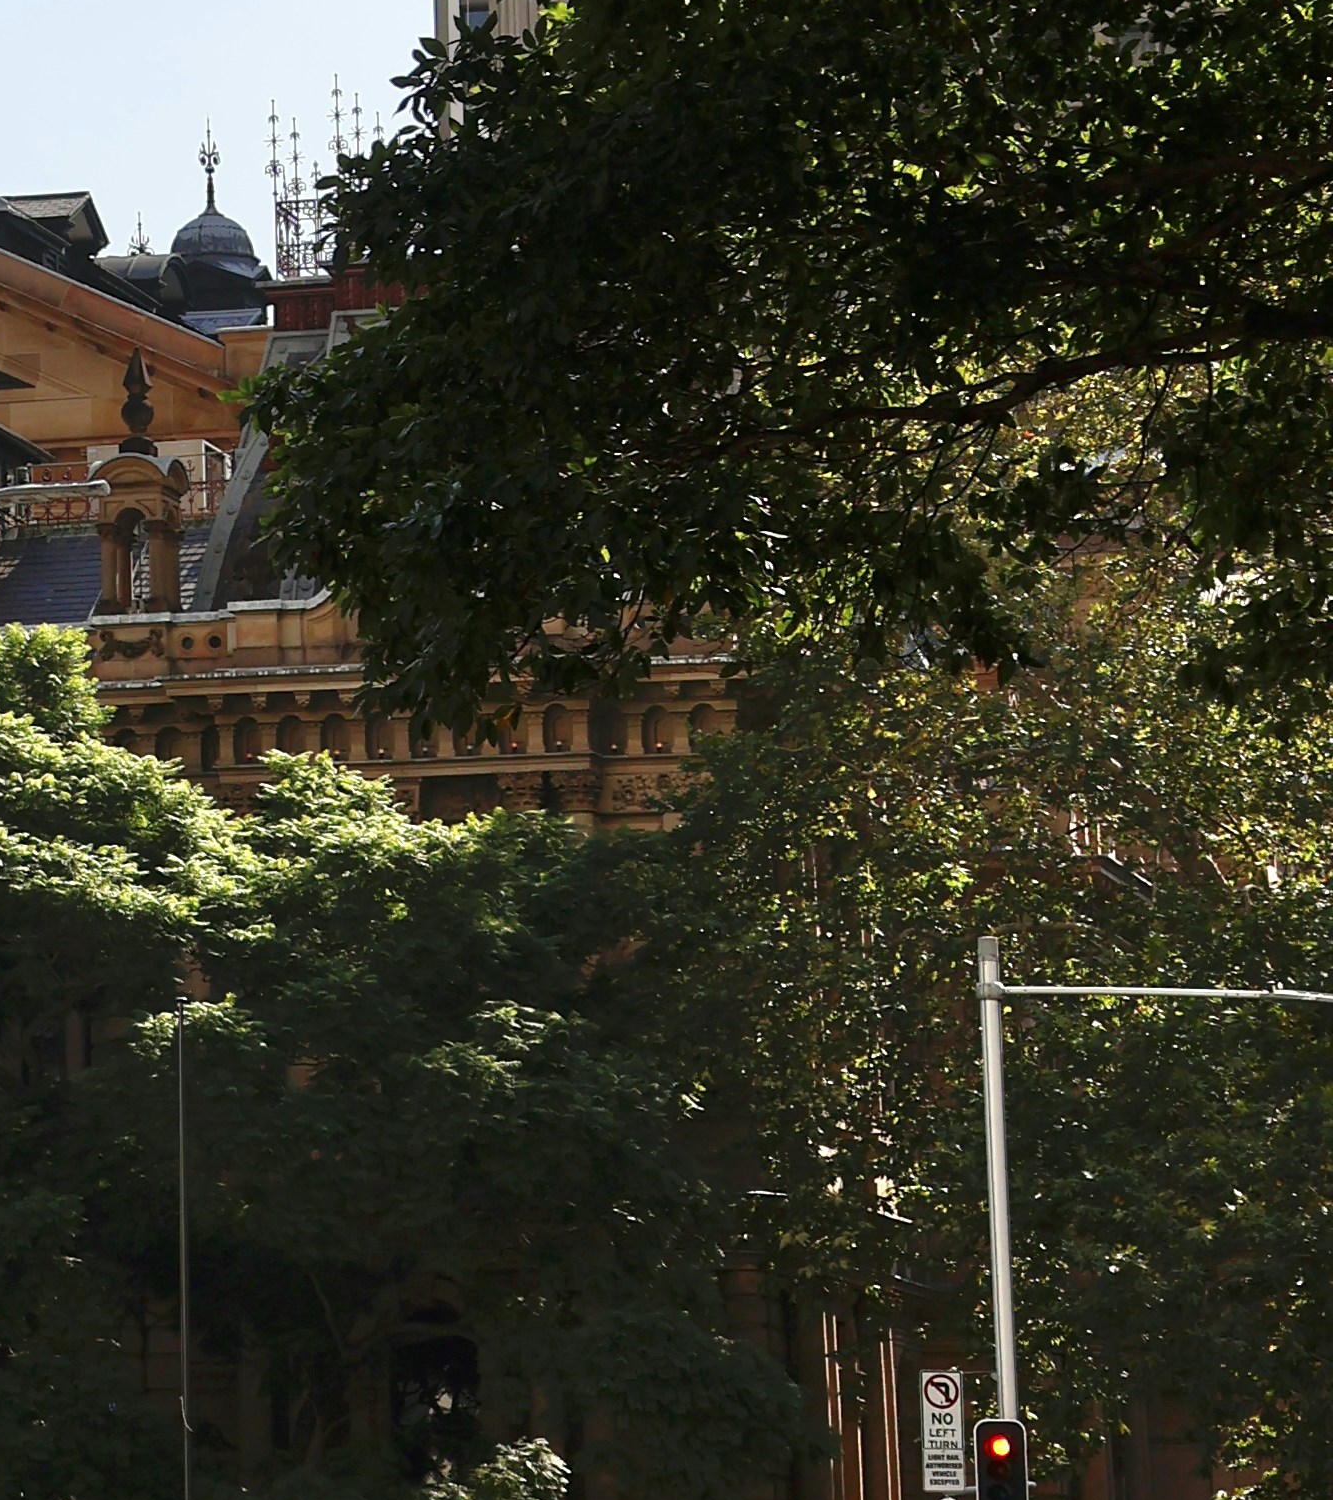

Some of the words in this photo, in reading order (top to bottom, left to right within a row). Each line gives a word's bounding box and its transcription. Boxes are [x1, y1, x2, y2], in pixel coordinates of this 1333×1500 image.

[931, 1412, 954, 1425] NO
[929, 1428, 957, 1438] LEFT
[928, 1440, 958, 1449] TURN
